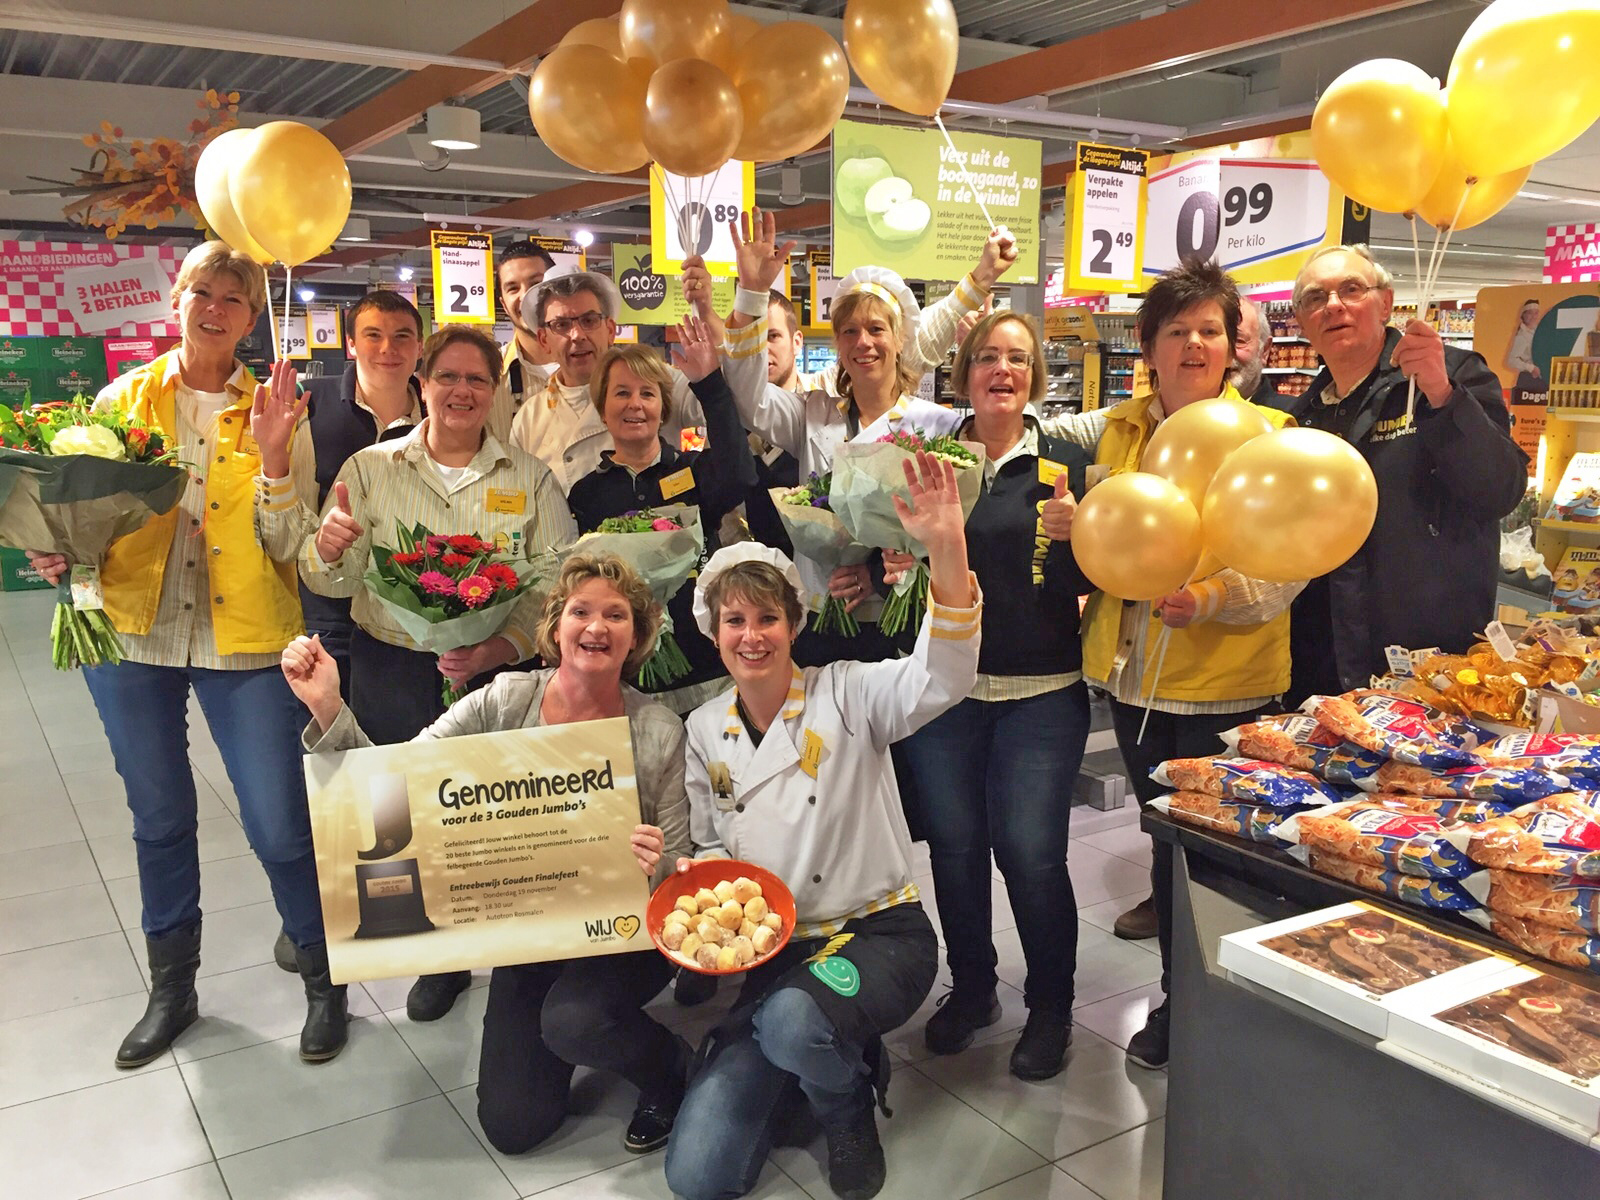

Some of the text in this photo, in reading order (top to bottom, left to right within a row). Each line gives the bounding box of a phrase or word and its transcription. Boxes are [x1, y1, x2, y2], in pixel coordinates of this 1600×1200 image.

[939, 145, 1011, 169] Vers uit de
[1120, 160, 1143, 174] Altijd.
[937, 163, 1038, 192] boomgaard, zo
[1088, 174, 1123, 187] Verpakte
[937, 183, 1021, 207] in de winkel
[1087, 188, 1118, 199] appelen
[936, 211, 956, 219] Lekker
[994, 215, 1008, 223] door
[1176, 182, 1273, 264] 0 99
[677, 201, 739, 256] 0 89
[467, 239, 488, 249] Altijd.
[960, 234, 972, 242] jaar
[1227, 234, 1266, 249] Per kilo
[1089, 228, 1133, 274] 2 49
[1555, 242, 1600, 262] MAA
[0, 252, 113, 267] AANDBIEDINGEN
[442, 258, 480, 267] sinaasappel
[76, 277, 142, 299] 3 HALEN
[620, 274, 664, 291] 100%
[81, 289, 162, 314] 2 BETALEN
[450, 284, 485, 313] 2 69
[623, 290, 664, 301] versgarantie
[292, 338, 306, 347] 99
[316, 328, 328, 343] 0
[59, 379, 91, 388] Heineken
[1521, 390, 1549, 403] Dagel
[1519, 440, 1540, 448] Servic
[441, 799, 587, 826] voor de 3 Gouden Jumbo's
[444, 837, 486, 848] Gefeliciteerd!
[502, 833, 524, 841] winkel
[524, 830, 548, 839] behoort
[445, 852, 454, 860] 20
[472, 848, 493, 856] Jumbo
[493, 845, 517, 853] winkels
[532, 838, 573, 851] genomineerd
[588, 835, 597, 843] de
[446, 860, 483, 871] felbegeerde
[483, 857, 508, 866] Gouden
[449, 869, 579, 892] Entreebewijs Gouden Finalefeest
[380, 884, 401, 893] 2015
[483, 889, 517, 900] Donderdag
[526, 884, 558, 895] november
[452, 904, 481, 915] Aanvang:
[453, 908, 545, 925] Locatie: Autotron Rosmalen
[584, 918, 613, 938] WIJ
